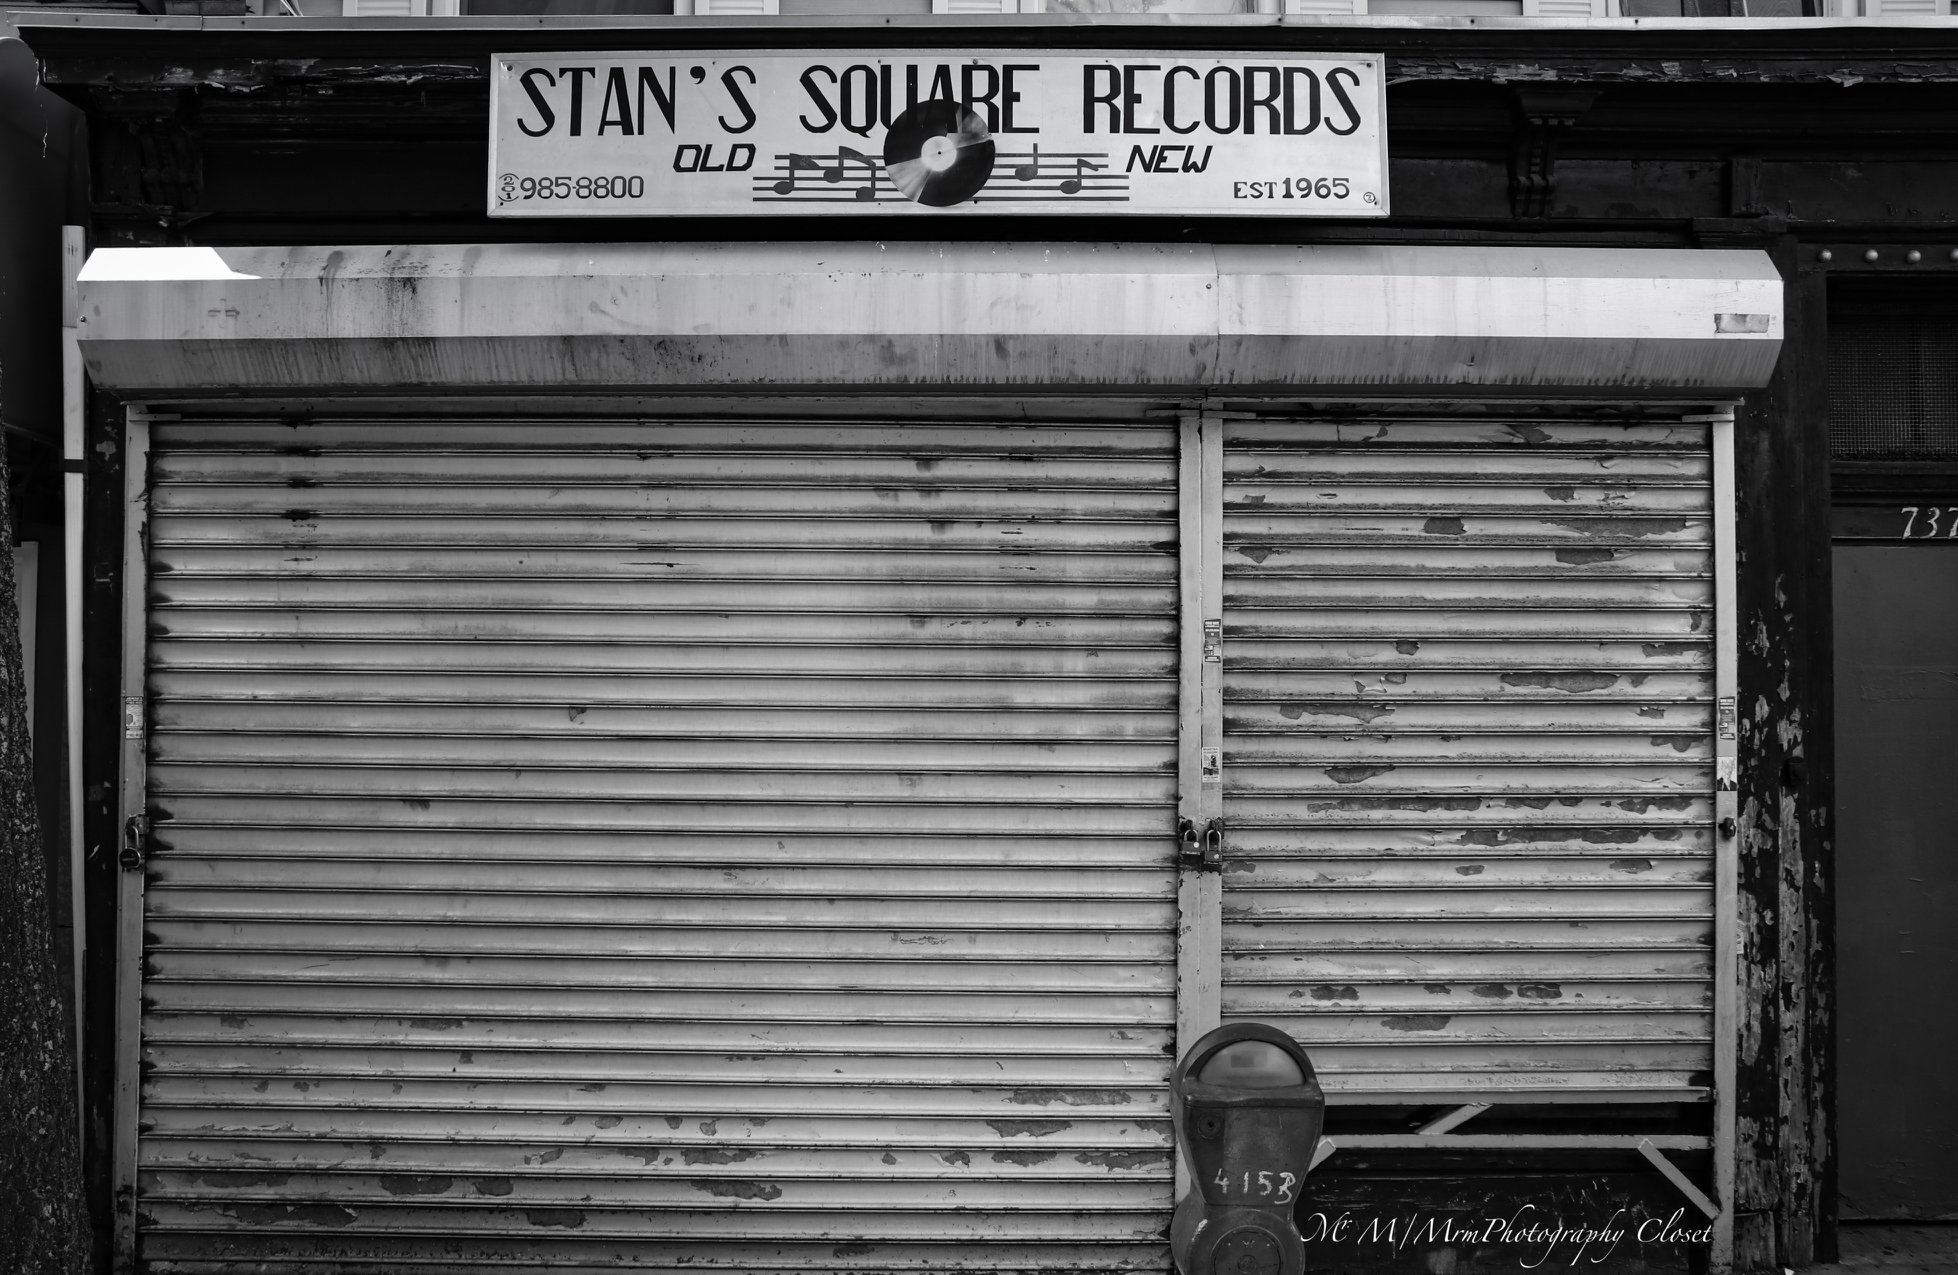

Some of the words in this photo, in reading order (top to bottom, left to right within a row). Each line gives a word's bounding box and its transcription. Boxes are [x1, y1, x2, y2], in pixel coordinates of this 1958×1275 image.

[517, 65, 757, 138] STAN'S
[799, 63, 1040, 139] SQUARE
[1083, 64, 1361, 136] RECORDS
[672, 143, 757, 173] OLD
[1125, 144, 1213, 173] NEW
[1233, 181, 1278, 199] EST
[1281, 177, 1350, 199] 1965
[1900, 506, 1958, 540] 737
